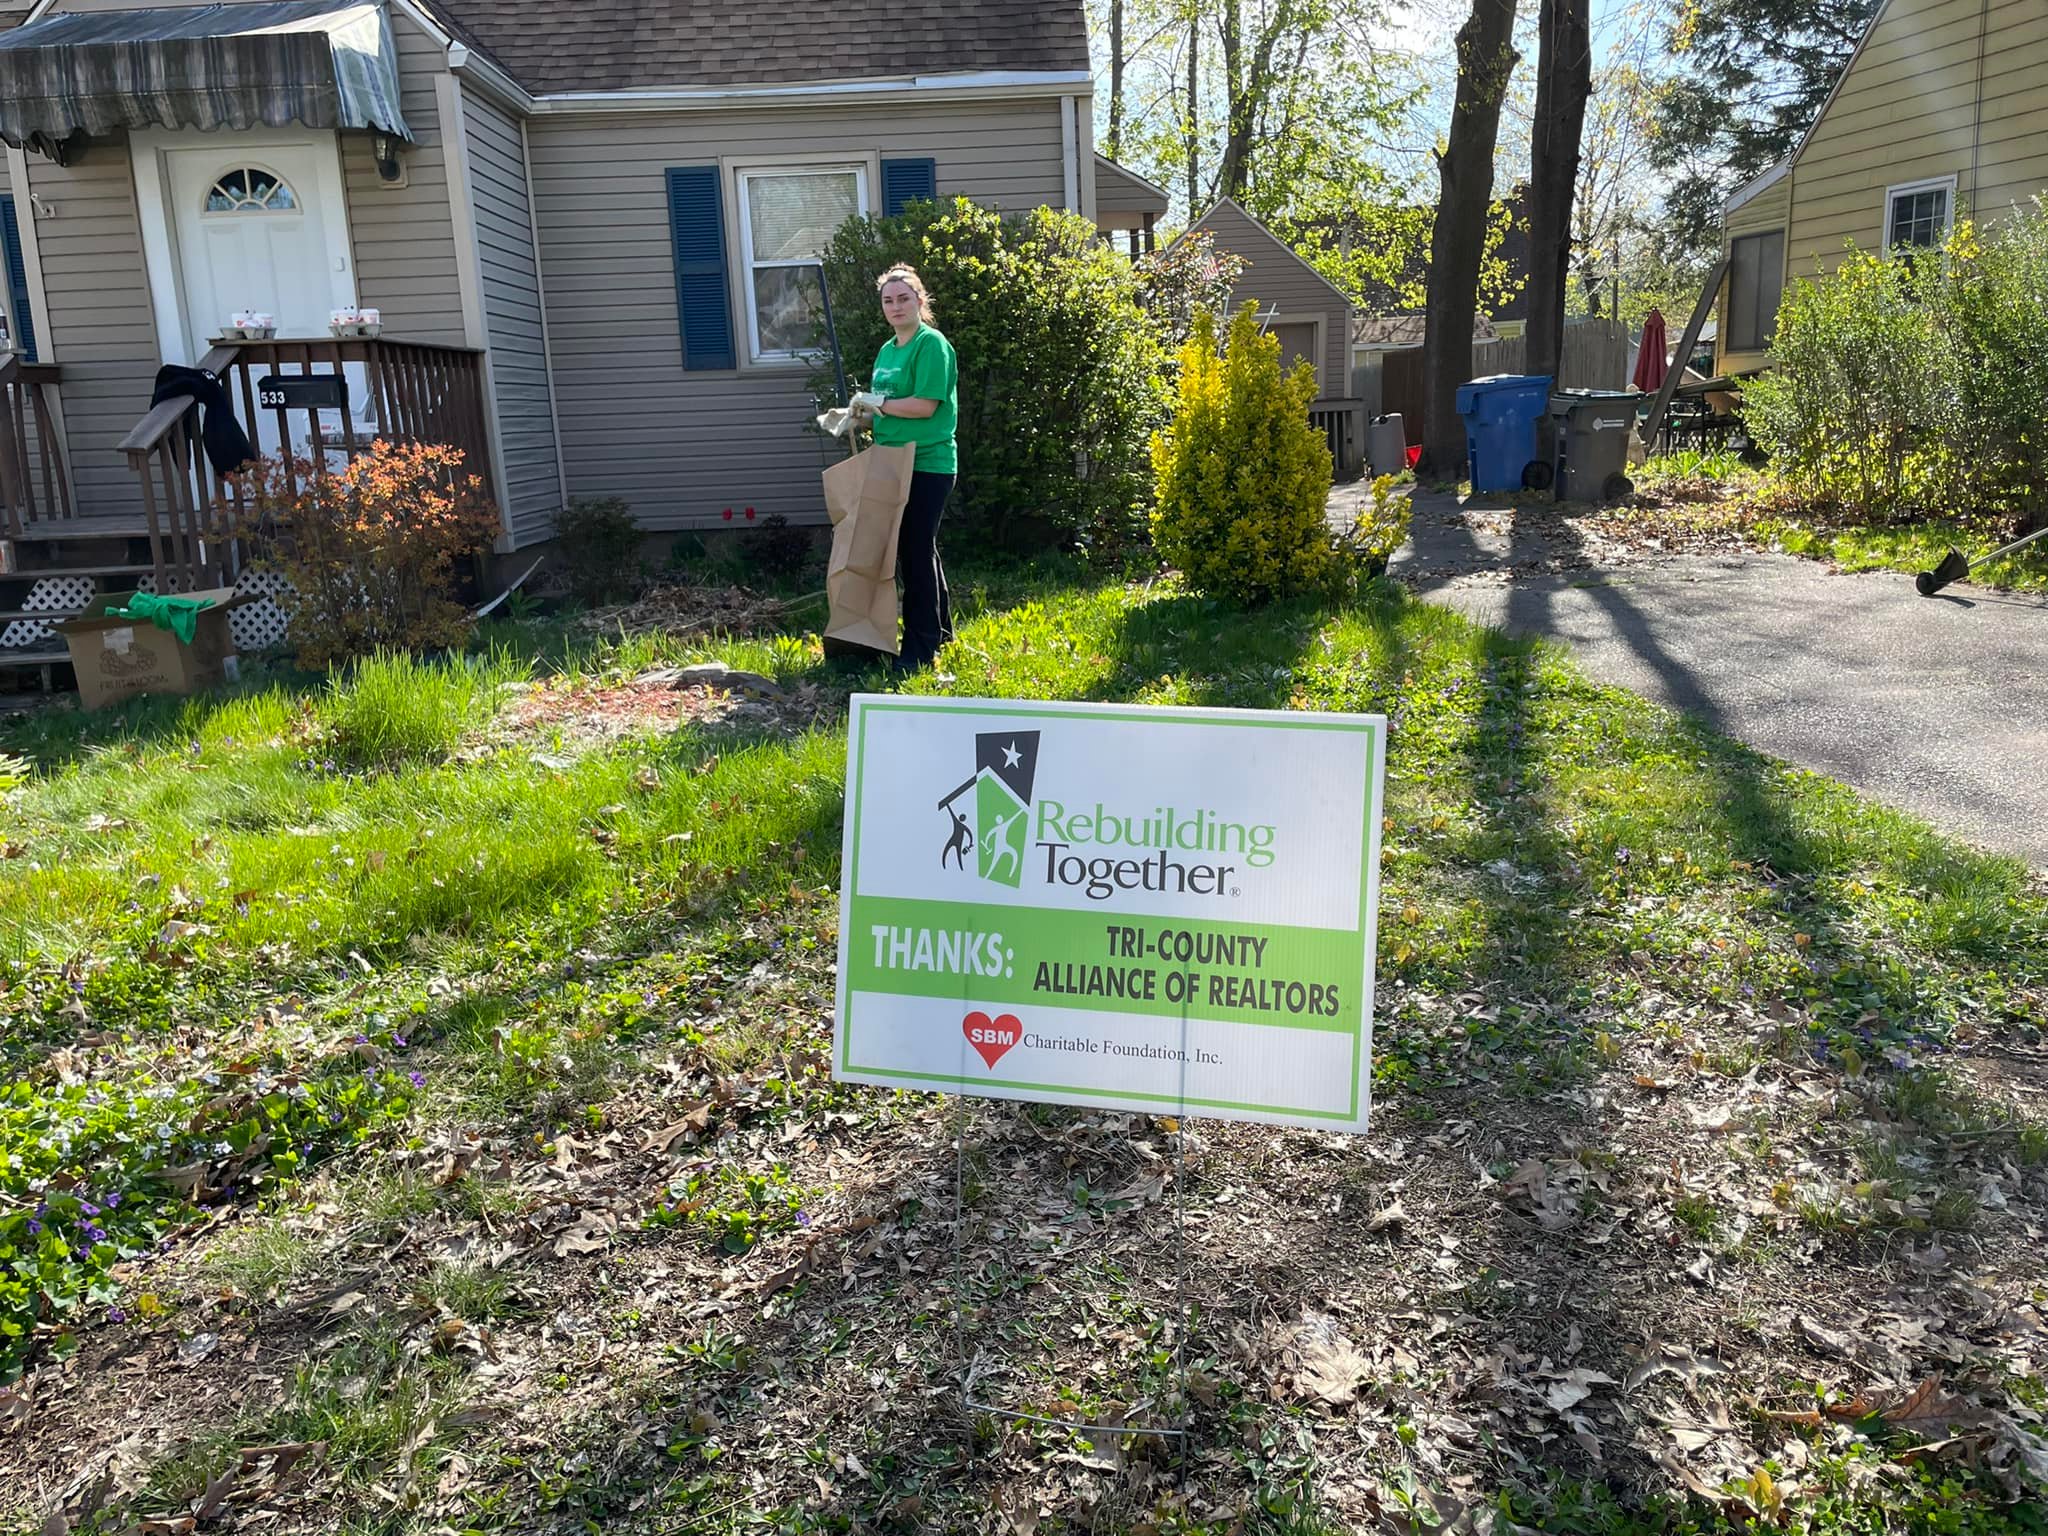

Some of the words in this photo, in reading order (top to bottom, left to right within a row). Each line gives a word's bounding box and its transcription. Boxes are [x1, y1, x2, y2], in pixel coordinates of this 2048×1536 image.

[261, 391, 286, 404] 533
[1036, 799, 1276, 868] Rebuilding
[871, 924, 1014, 979] THANKS:
[1106, 925, 1268, 968] TRI-COUNTY
[1032, 961, 1156, 1000] ALLIANCE
[1164, 971, 1200, 1004] OF
[1208, 974, 1340, 1017] REALTORS
[970, 1028, 1014, 1046] SBM
[1023, 1033, 1099, 1054] Charitable
[1102, 1040, 1190, 1063] Foundation,
[1195, 1048, 1223, 1065] Inc.
